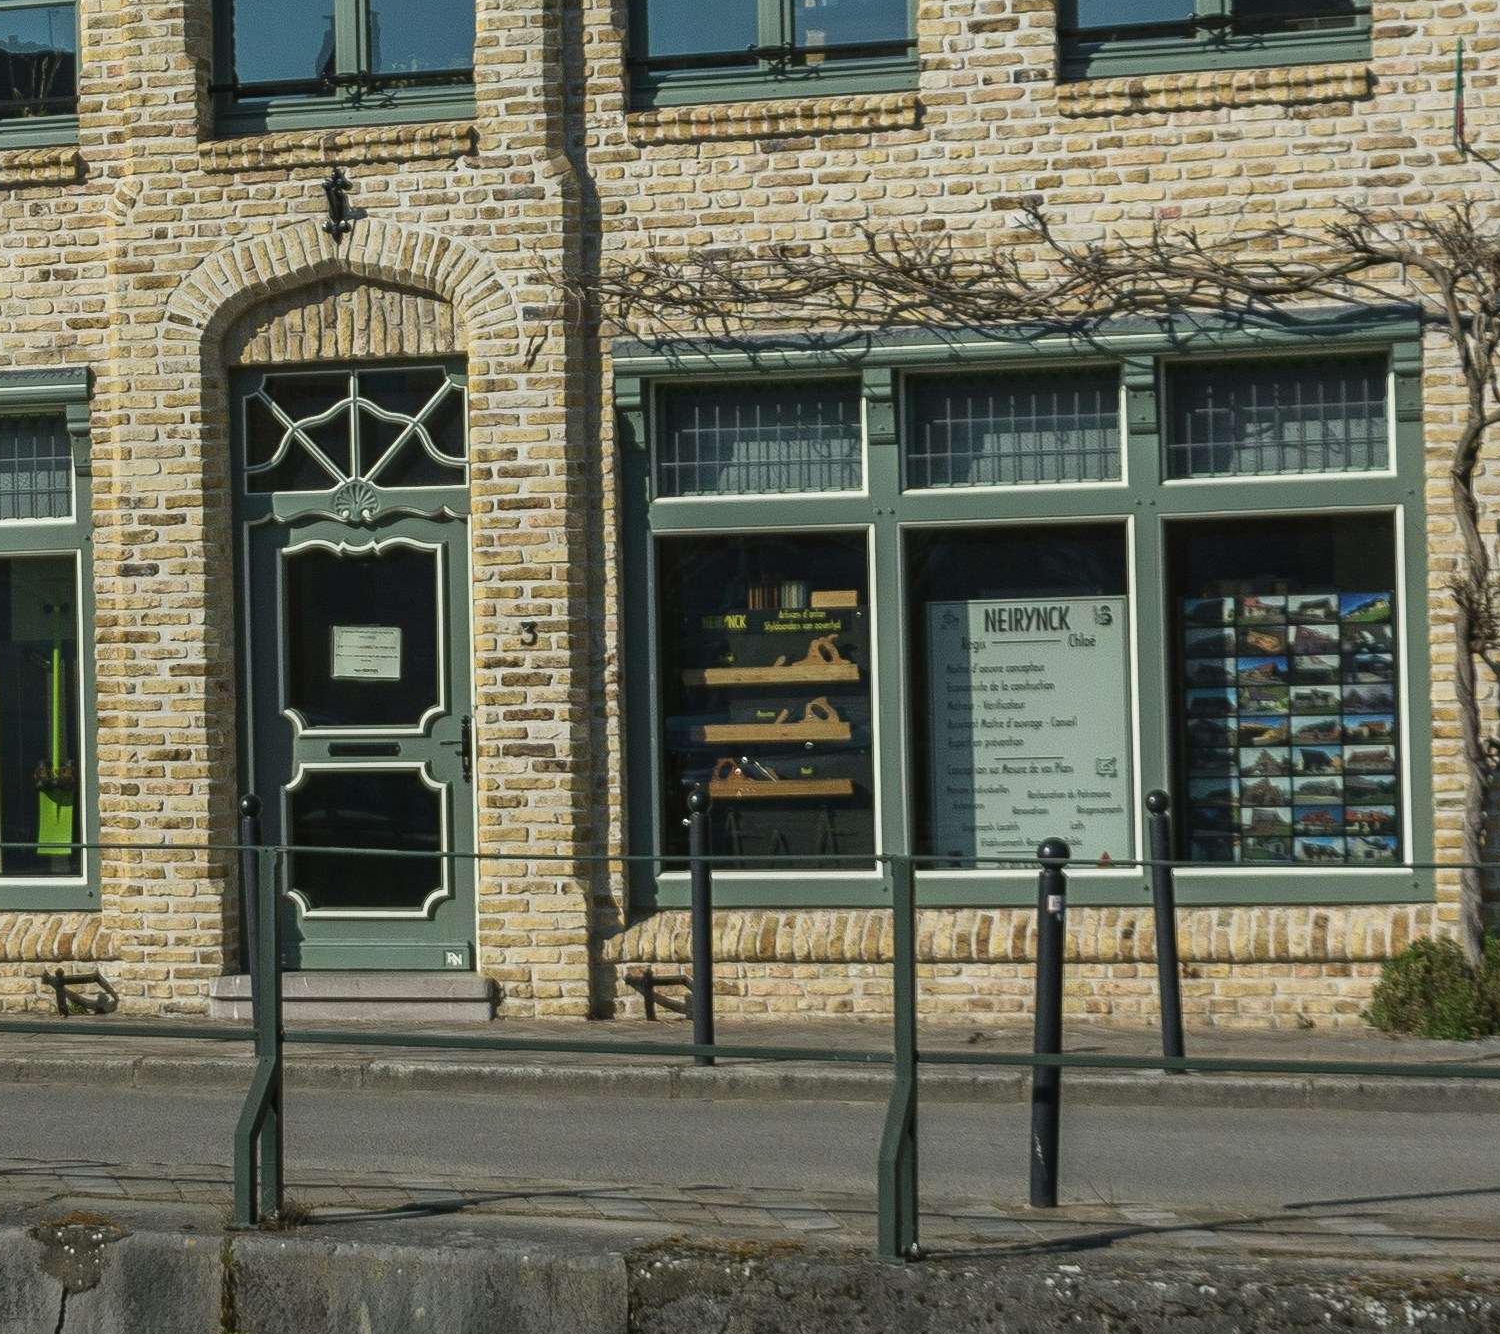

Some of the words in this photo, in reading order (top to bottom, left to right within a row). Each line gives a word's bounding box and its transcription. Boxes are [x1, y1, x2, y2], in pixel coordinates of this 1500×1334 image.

[984, 605, 1072, 633] NEIRYNCK
[520, 620, 539, 646] 3
[1010, 679, 1056, 691] construction
[1051, 715, 1079, 727] Conseil
